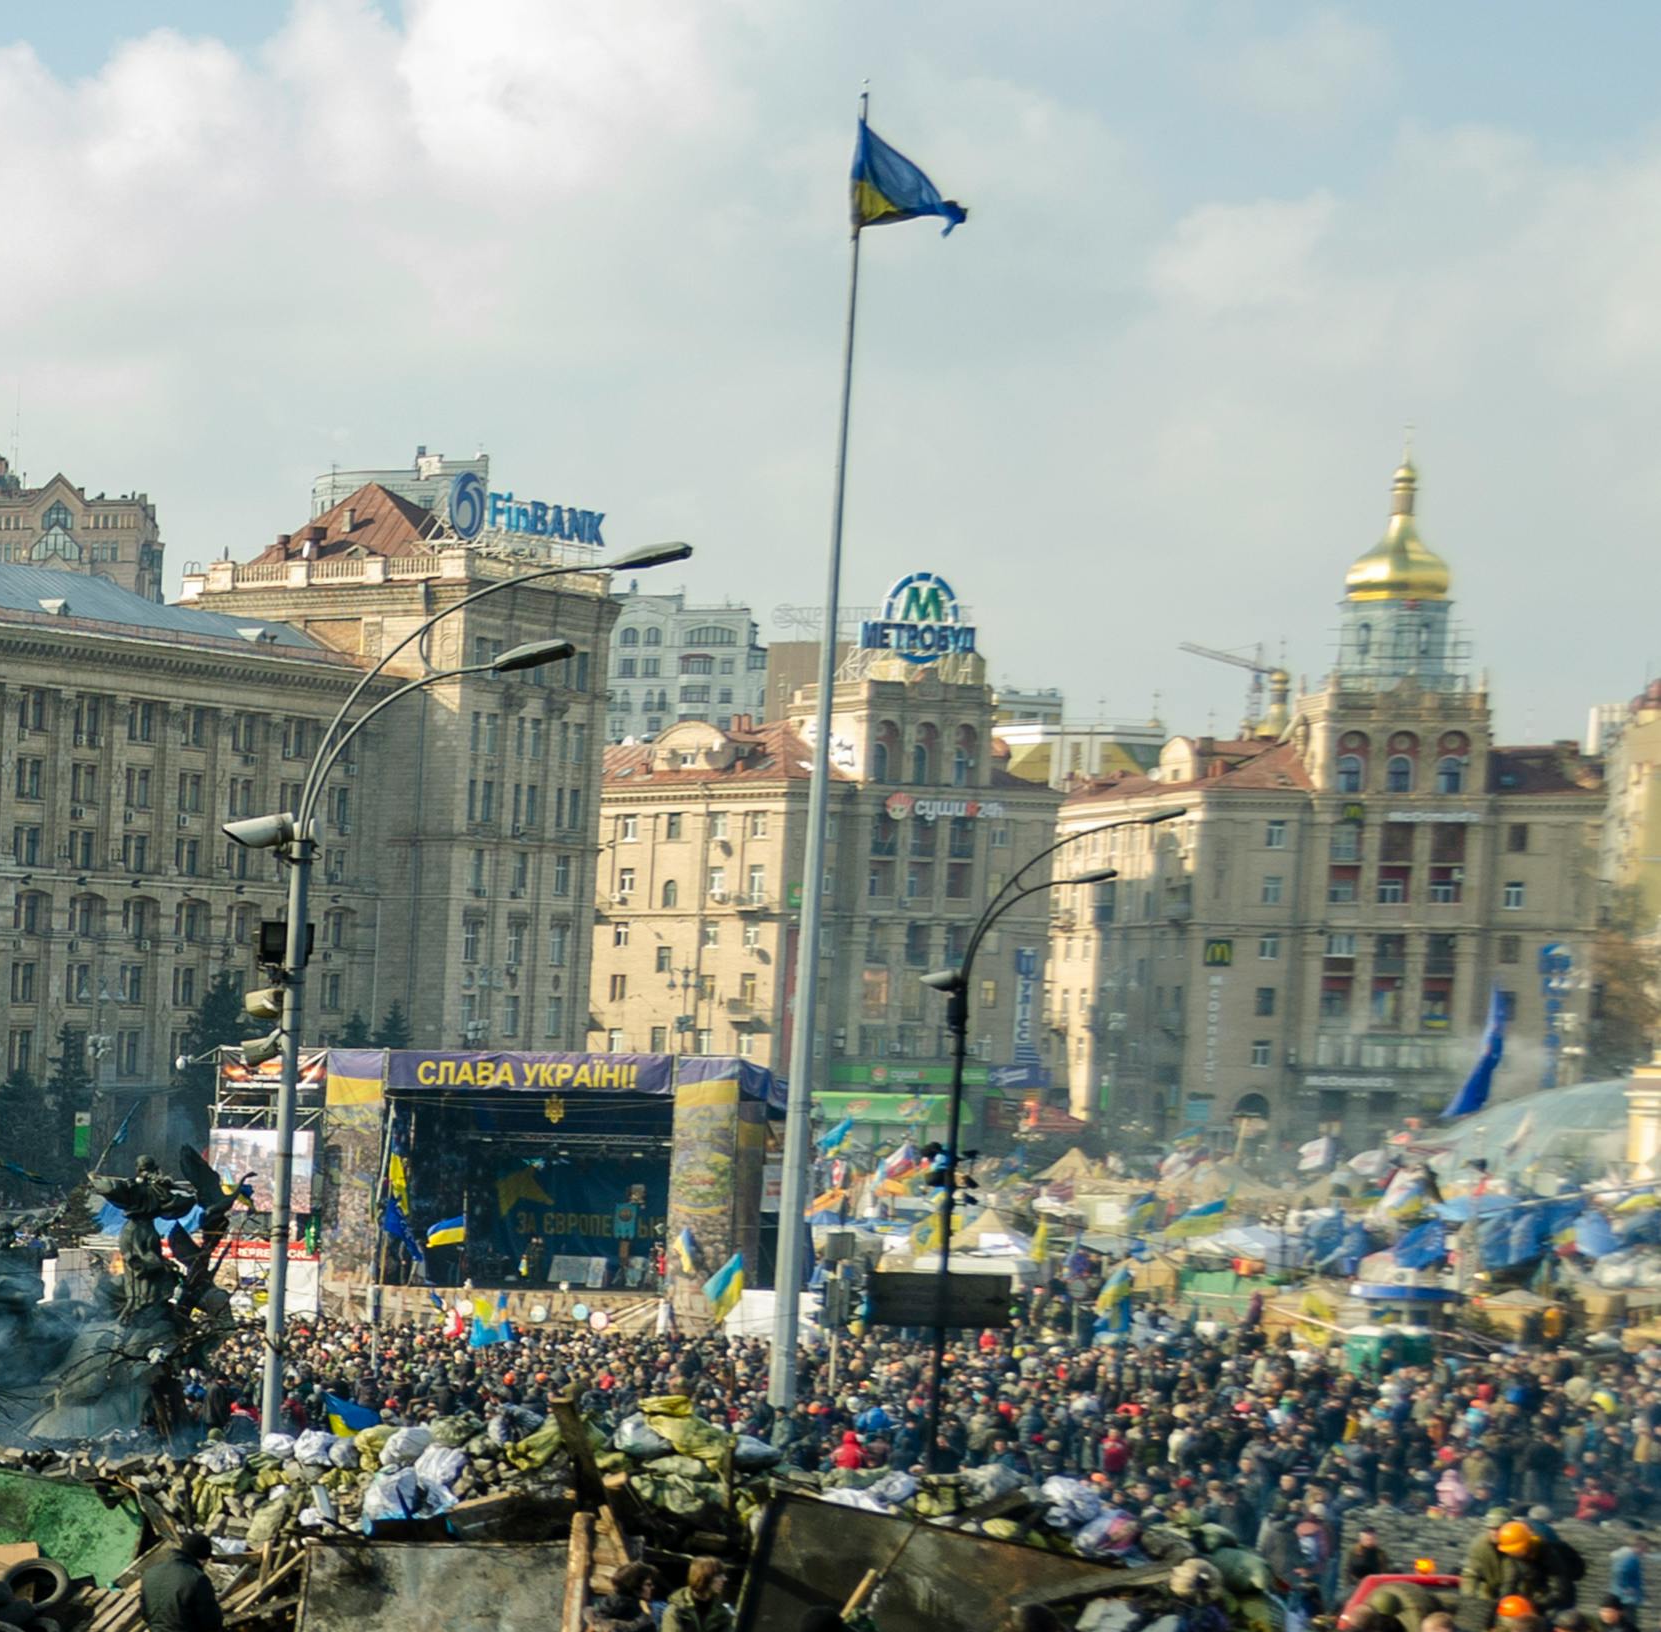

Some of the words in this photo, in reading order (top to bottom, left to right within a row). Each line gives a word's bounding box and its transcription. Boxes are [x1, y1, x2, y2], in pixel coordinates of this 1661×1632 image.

[489, 490, 605, 546] FinBANK
[858, 621, 977, 654] МЕТРОБУД
[417, 1060, 515, 1087] СЛАВА
[522, 1061, 638, 1089] УКРАЇНІ!
[516, 1211, 536, 1234] ЗА
[543, 1212, 666, 1239] ЄВРОПЕЬ
